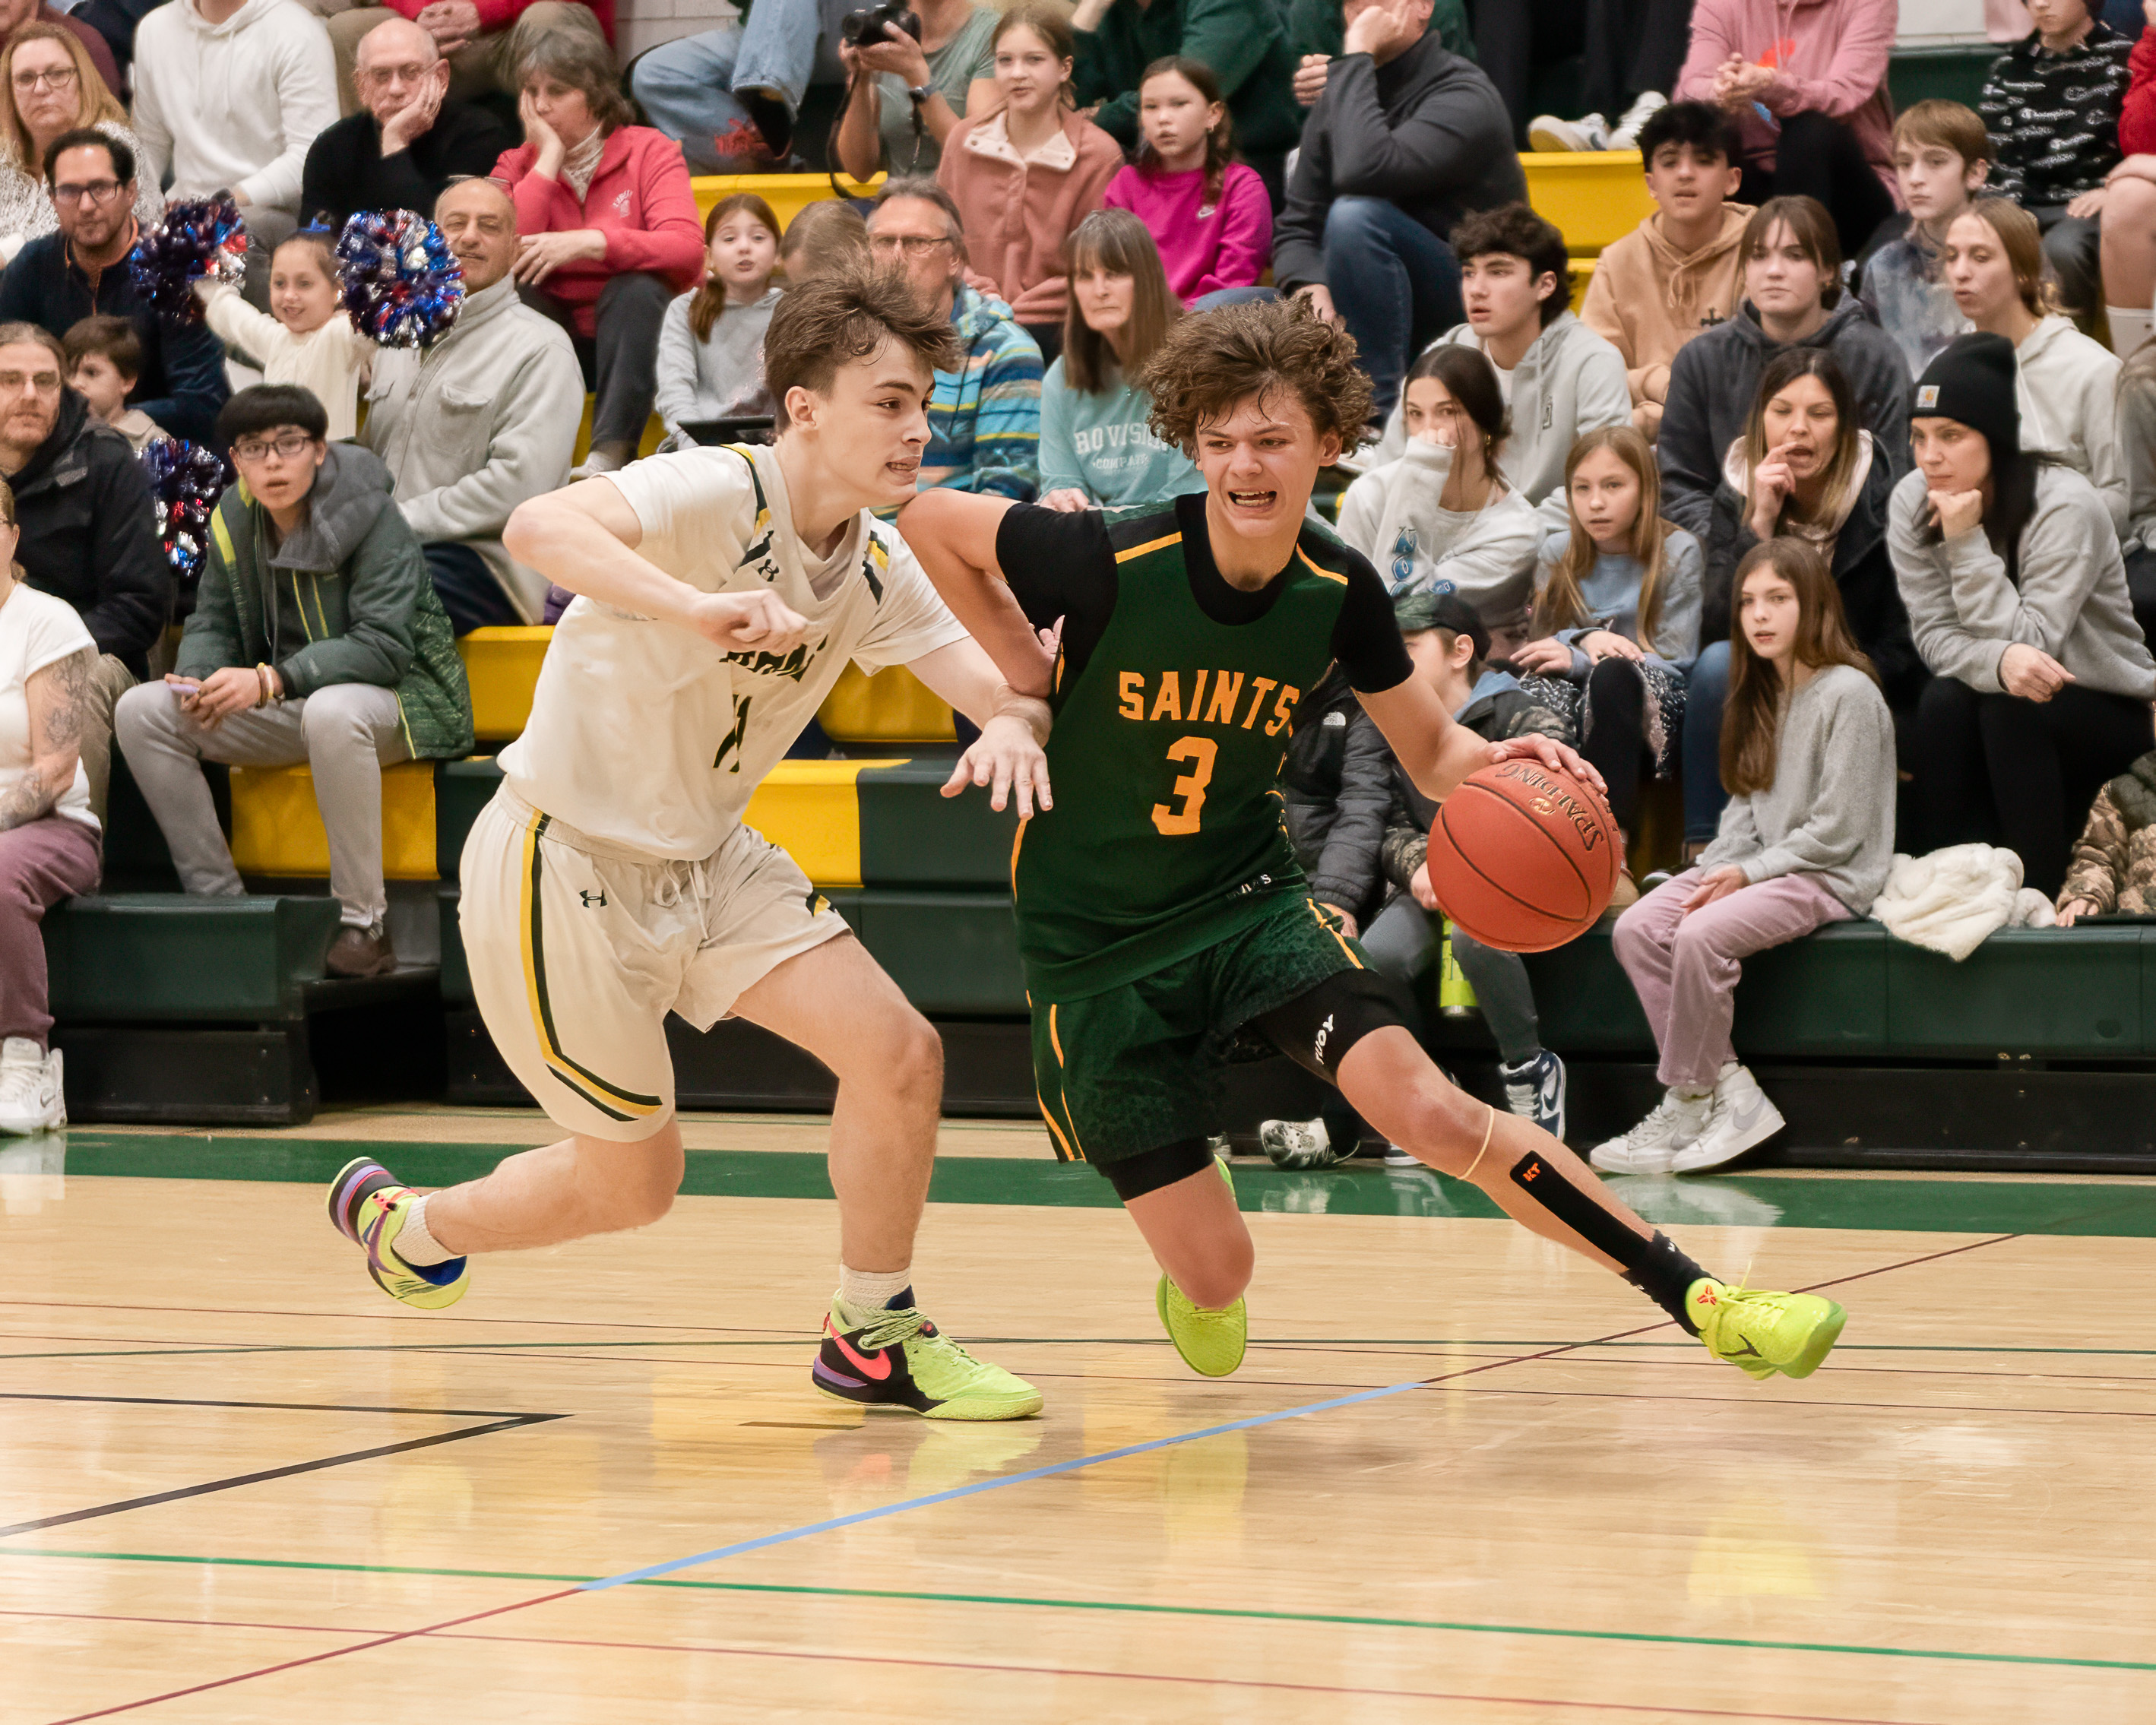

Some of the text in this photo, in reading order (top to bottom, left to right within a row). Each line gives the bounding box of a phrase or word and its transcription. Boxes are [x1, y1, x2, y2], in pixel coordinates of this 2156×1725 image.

[1118, 669, 1300, 737] SAINTS
[1151, 735, 1219, 836] 3
[1495, 761, 1605, 852] SPALDING
